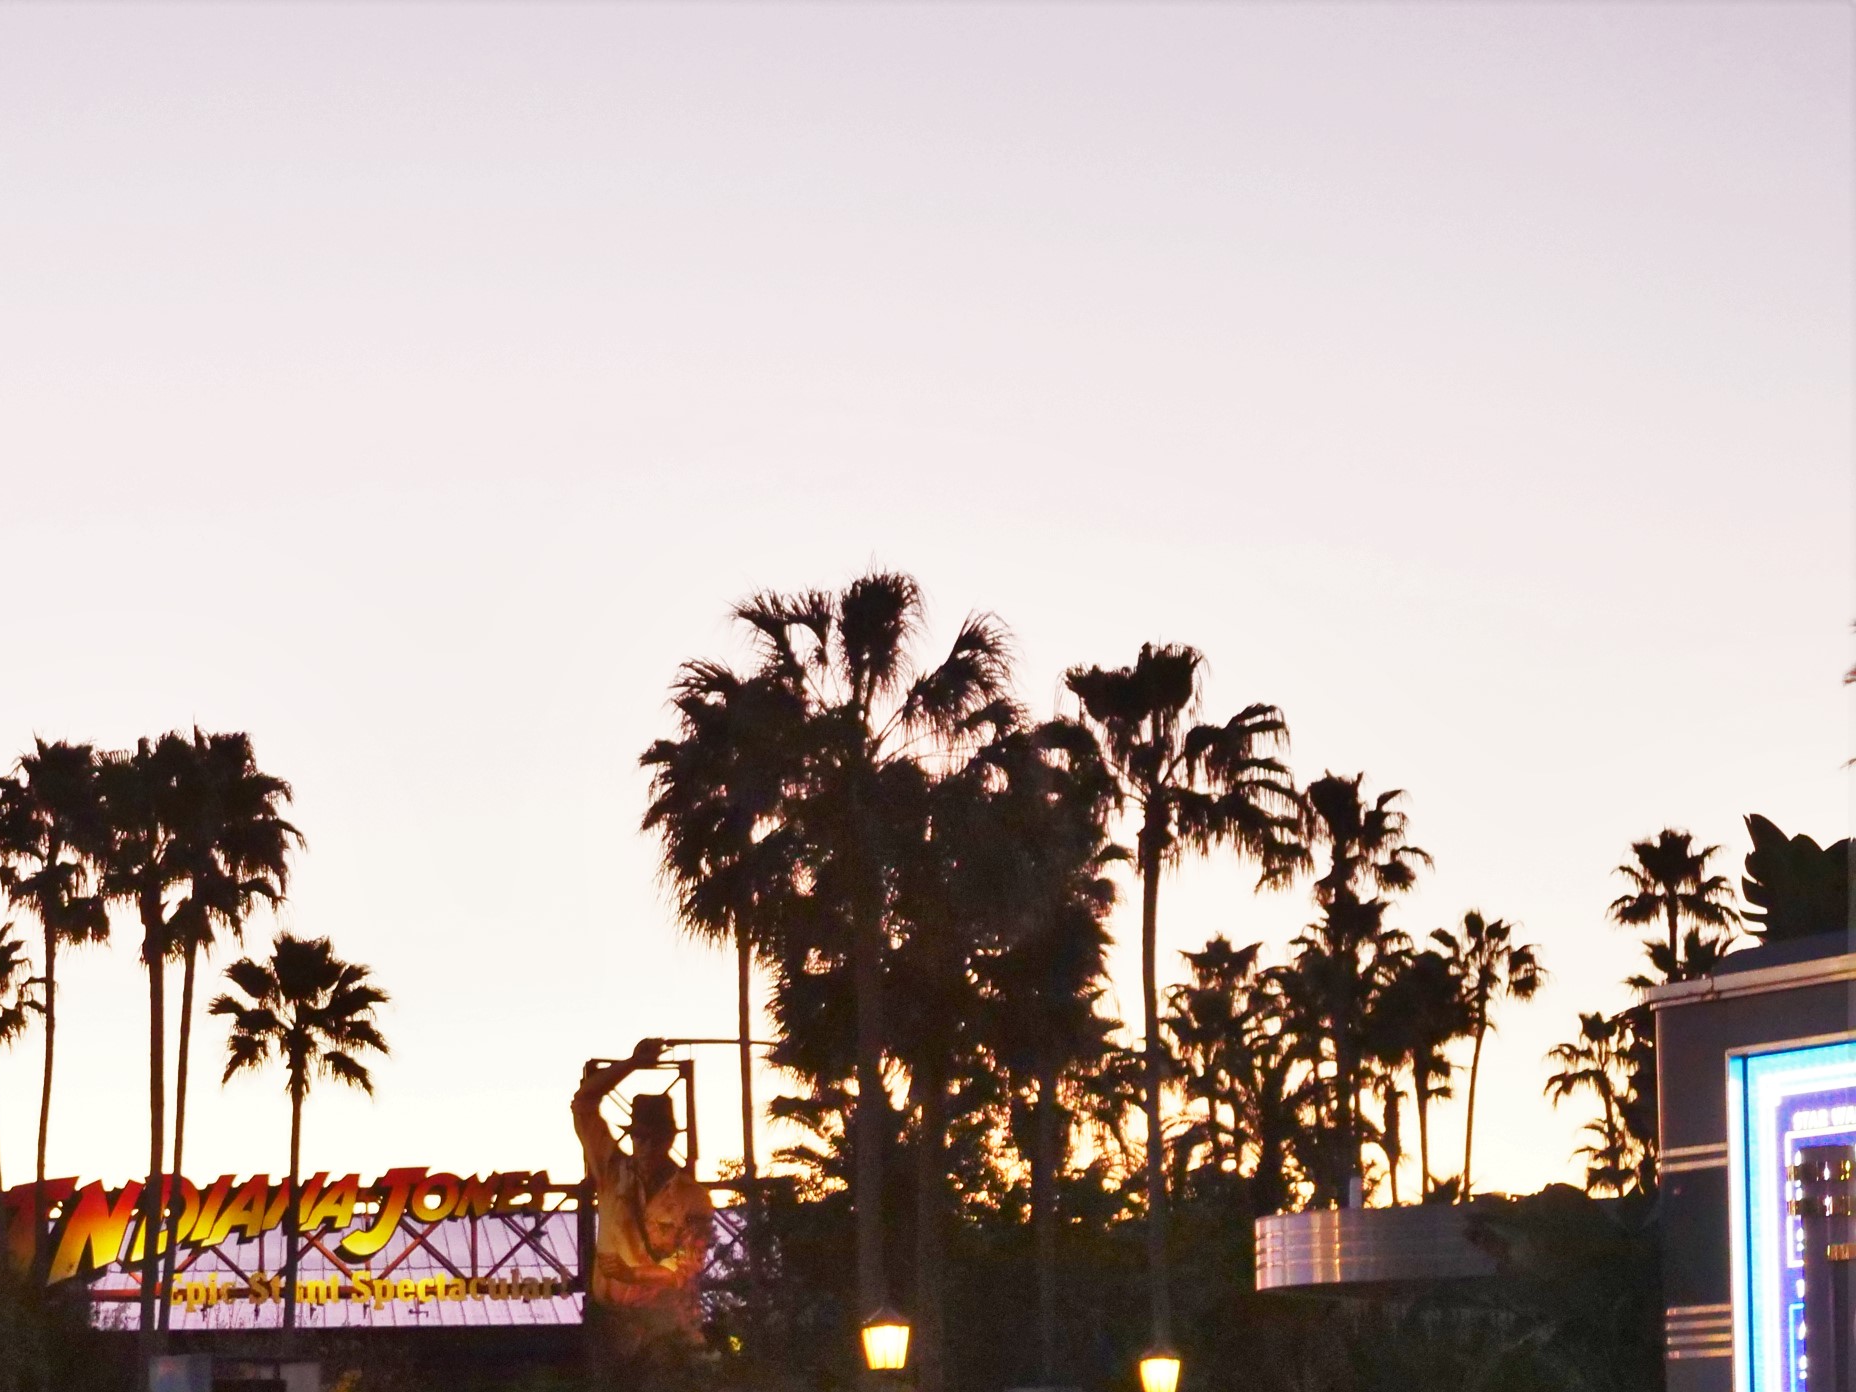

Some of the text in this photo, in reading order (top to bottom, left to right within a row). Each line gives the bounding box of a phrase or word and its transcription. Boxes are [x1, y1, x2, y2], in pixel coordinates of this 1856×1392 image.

[1792, 1105, 1856, 1131] STAR WA
[1, 1167, 550, 1287] INDIANA JONES
[351, 1268, 570, 1311] Spectacular!
